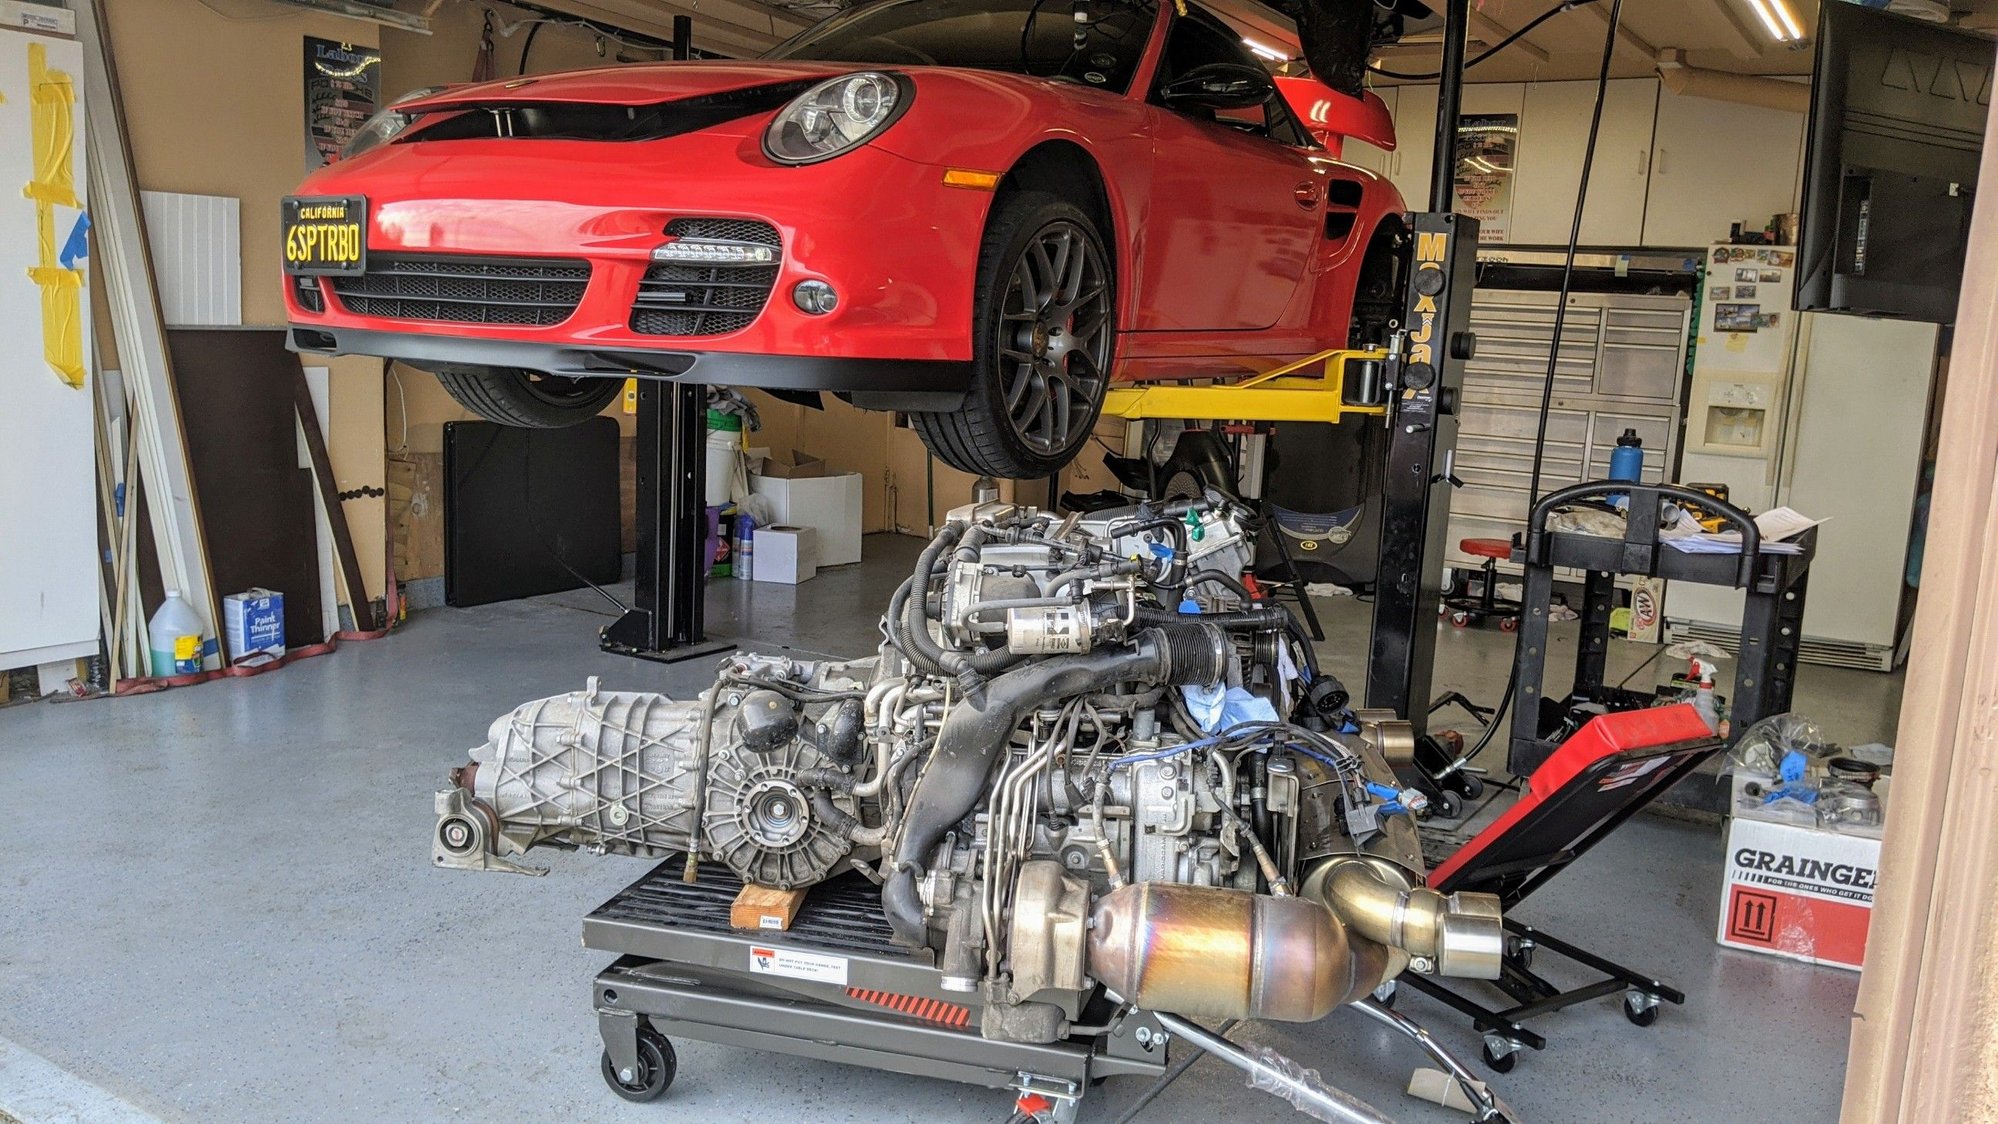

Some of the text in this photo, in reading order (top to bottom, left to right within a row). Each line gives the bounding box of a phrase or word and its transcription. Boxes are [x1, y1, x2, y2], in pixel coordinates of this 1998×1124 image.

[300, 205, 345, 219] CALIFORNIA
[255, 611, 275, 625] Paint
[250, 622, 280, 634] Thinner
[1799, 883, 1819, 892] ONES
[1820, 887, 1837, 895] WHO
